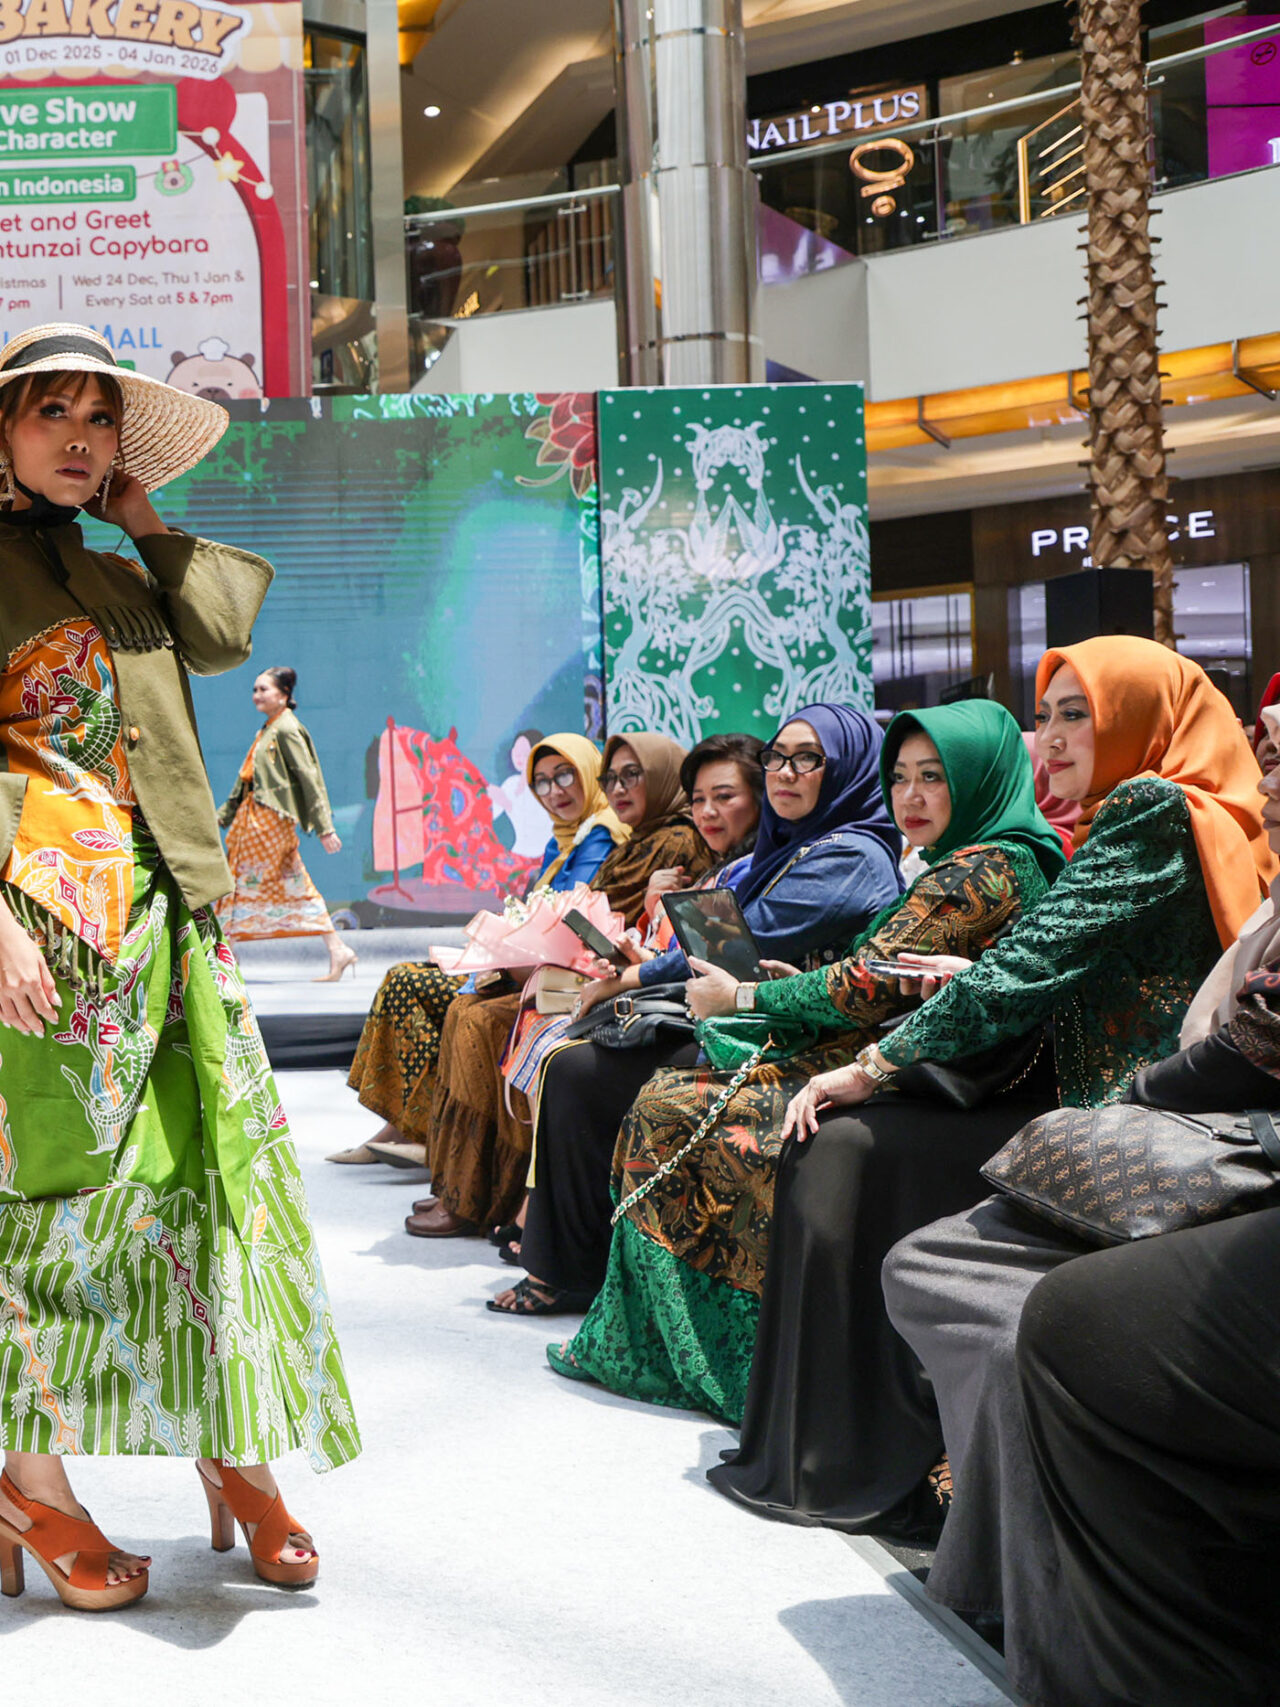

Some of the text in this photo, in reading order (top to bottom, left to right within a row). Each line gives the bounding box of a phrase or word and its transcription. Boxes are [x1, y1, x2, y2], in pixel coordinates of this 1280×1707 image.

[4, 50, 21, 65] 01
[26, 47, 57, 62] Dec
[64, 45, 102, 60] 2025
[118, 47, 137, 61] 04
[143, 51, 175, 66] Jan
[181, 55, 219, 74] 2026
[45, 96, 137, 125] Show
[823, 91, 920, 135] PLUS
[13, 173, 125, 197] Indonesia
[30, 211, 76, 231] and
[85, 210, 152, 230] Greet
[89, 235, 210, 260] Capybara
[72, 274, 102, 287] Wed
[106, 274, 123, 286] 24
[127, 273, 158, 286] Dec,
[162, 271, 190, 285] Thu
[203, 271, 231, 284] Jan
[234, 270, 245, 283] &
[8, 298, 30, 311] pm
[86, 291, 234, 308] Every Sat at 5 & 7pm
